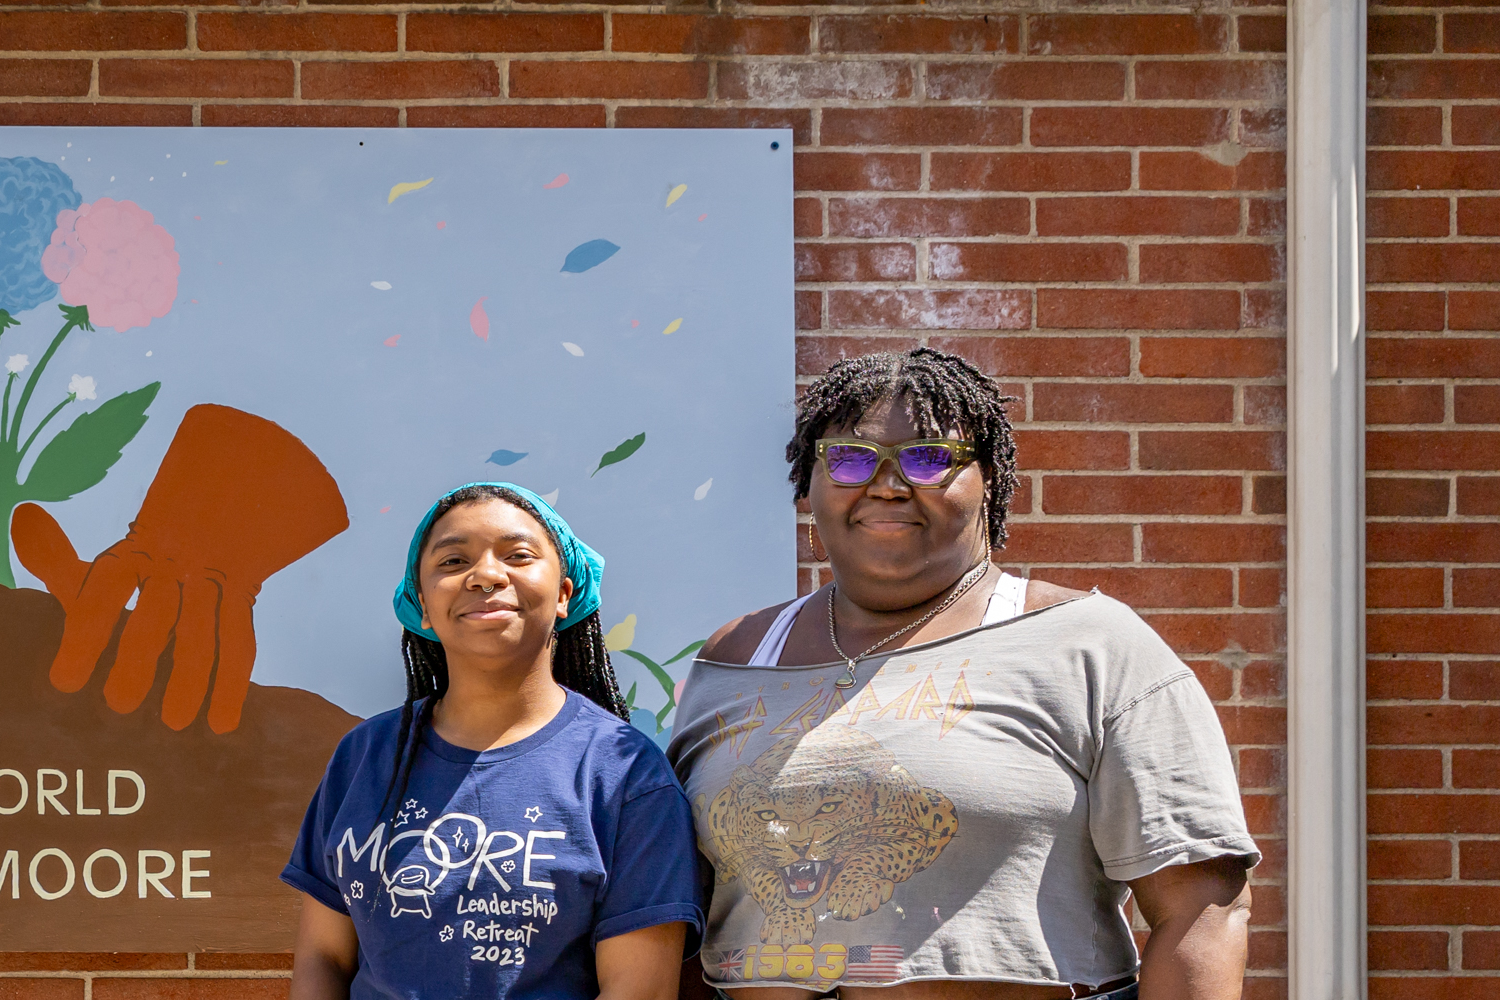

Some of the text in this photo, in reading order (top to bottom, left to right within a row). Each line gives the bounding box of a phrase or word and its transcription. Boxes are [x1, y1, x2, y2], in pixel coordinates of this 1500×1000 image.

[769, 670, 976, 741] LEPPARD
[336, 812, 566, 896] MOORE
[456, 892, 559, 925] Leadership
[462, 920, 540, 947] Retreat
[470, 945, 526, 966] 2023
[743, 943, 848, 979] 1983
